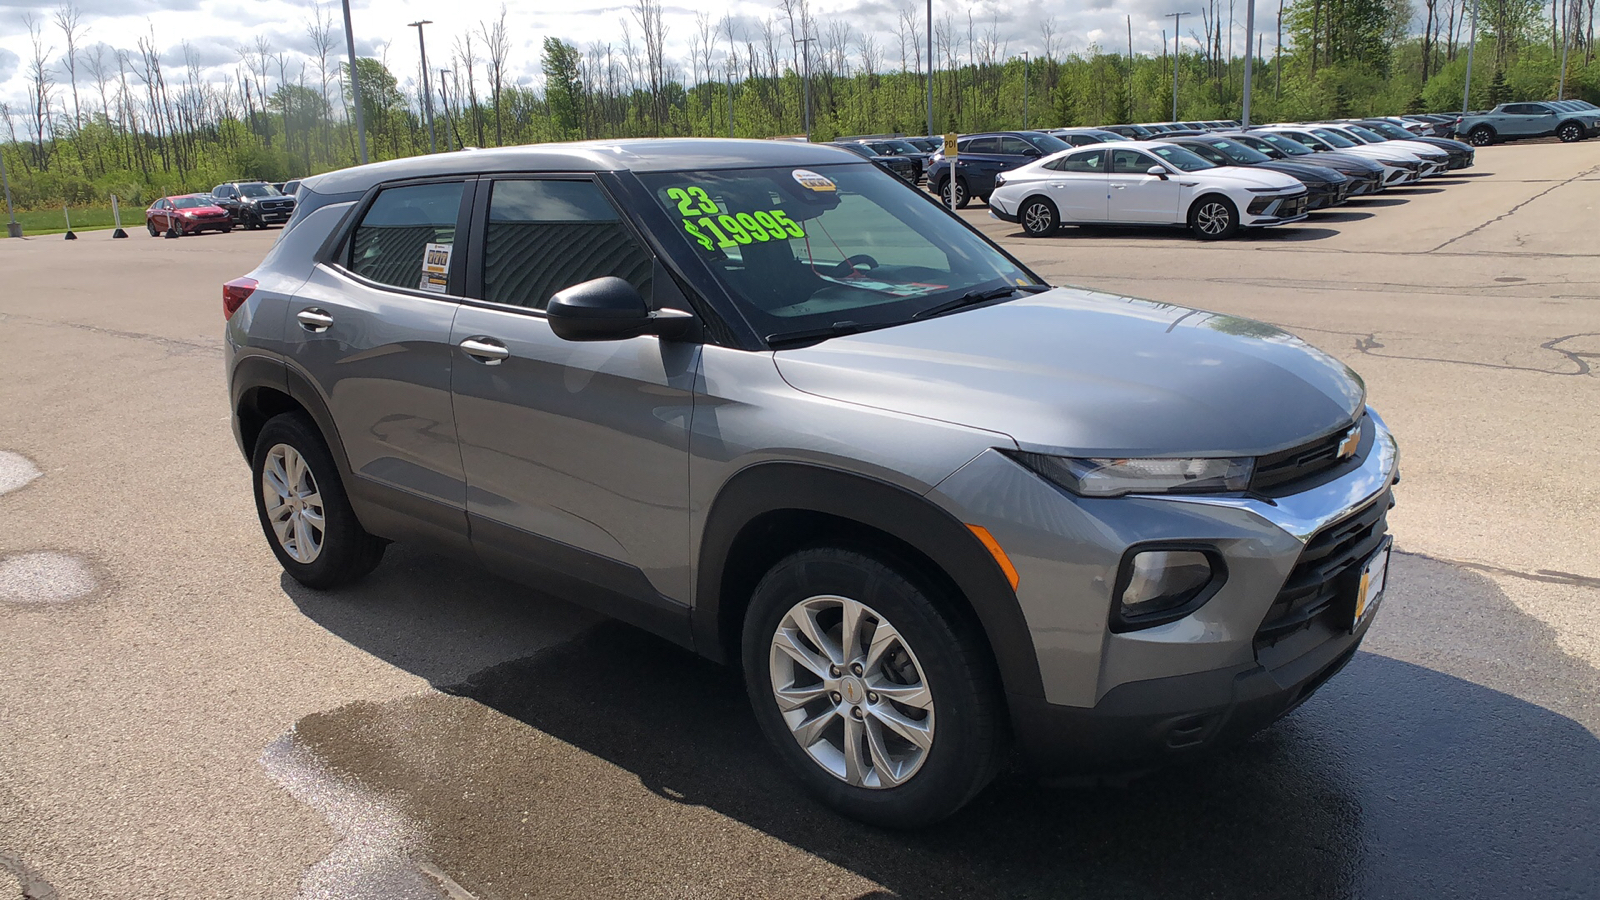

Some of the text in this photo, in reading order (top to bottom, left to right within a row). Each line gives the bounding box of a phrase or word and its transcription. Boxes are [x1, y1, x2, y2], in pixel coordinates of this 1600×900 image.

[945, 140, 956, 148] PDI
[667, 186, 719, 217] 23
[682, 209, 806, 251] $19995
